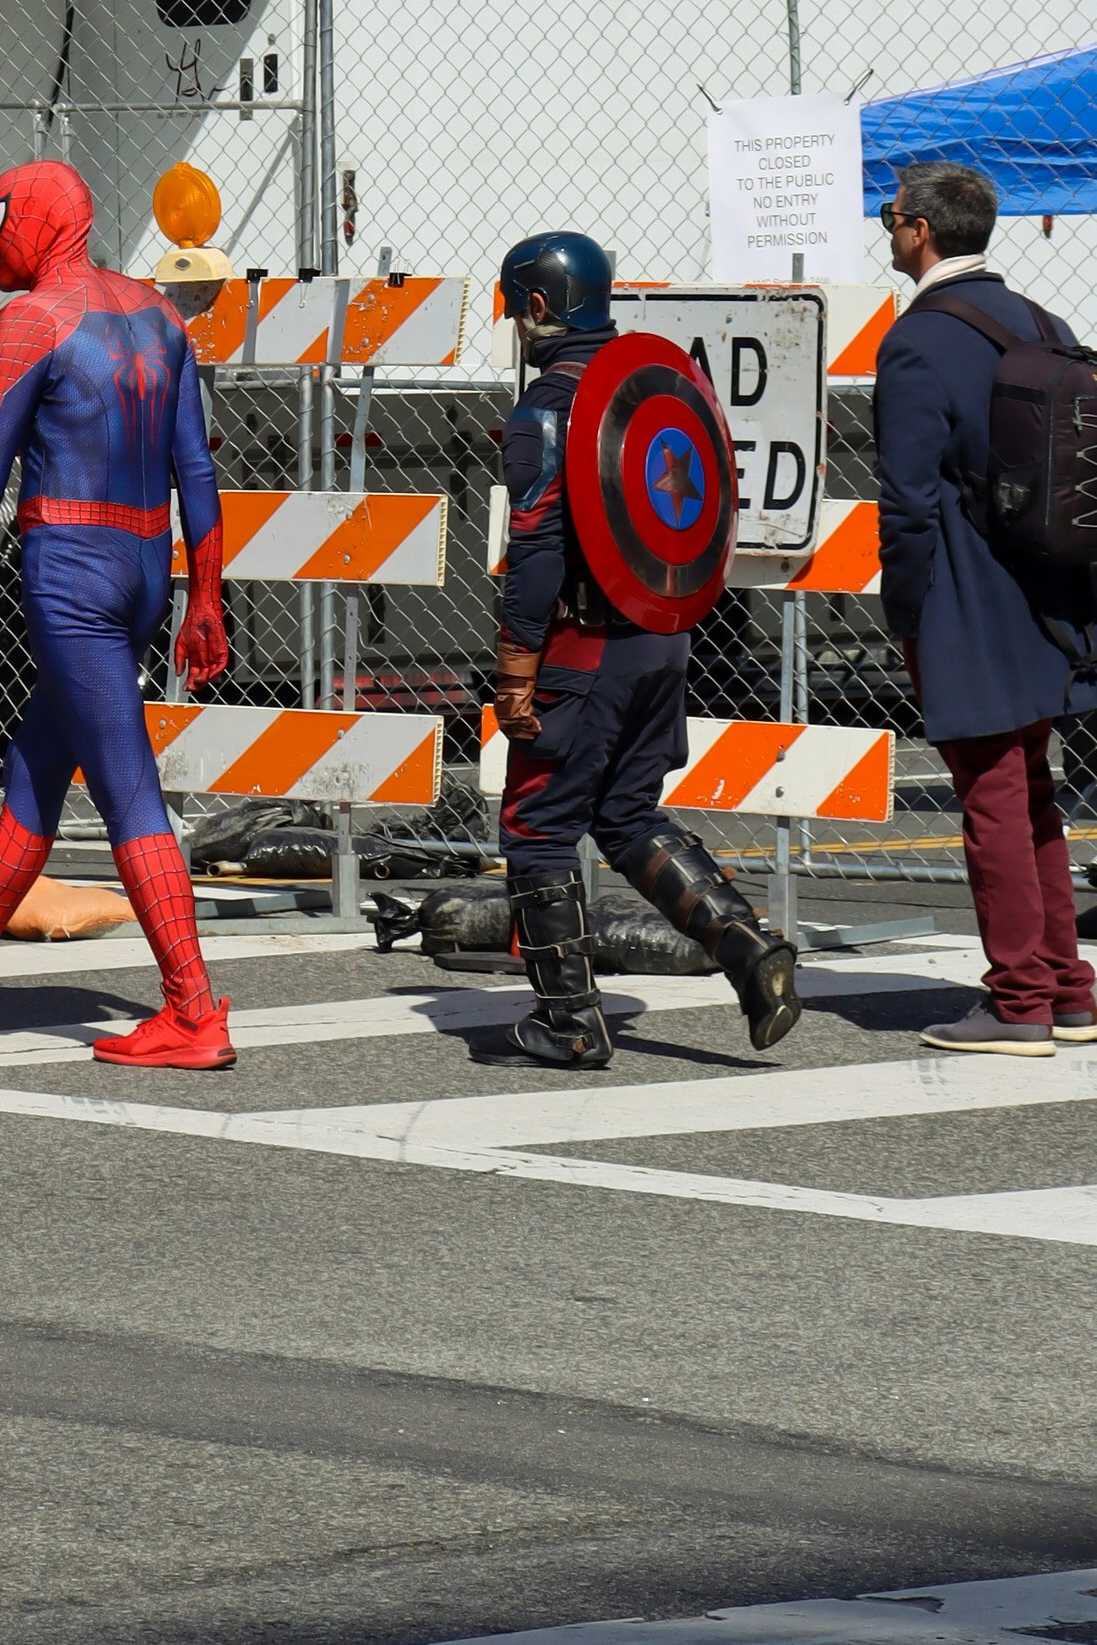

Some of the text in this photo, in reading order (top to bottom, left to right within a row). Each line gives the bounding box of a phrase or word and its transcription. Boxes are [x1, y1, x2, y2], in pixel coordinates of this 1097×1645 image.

[735, 133, 836, 153] THIS PROPERTY
[758, 154, 811, 171] CLOSED
[736, 172, 834, 191] TO THE PUBLIC
[753, 193, 819, 209] NO ENTRY
[756, 212, 817, 228] WITHOUT
[747, 231, 828, 248] PERMISSION
